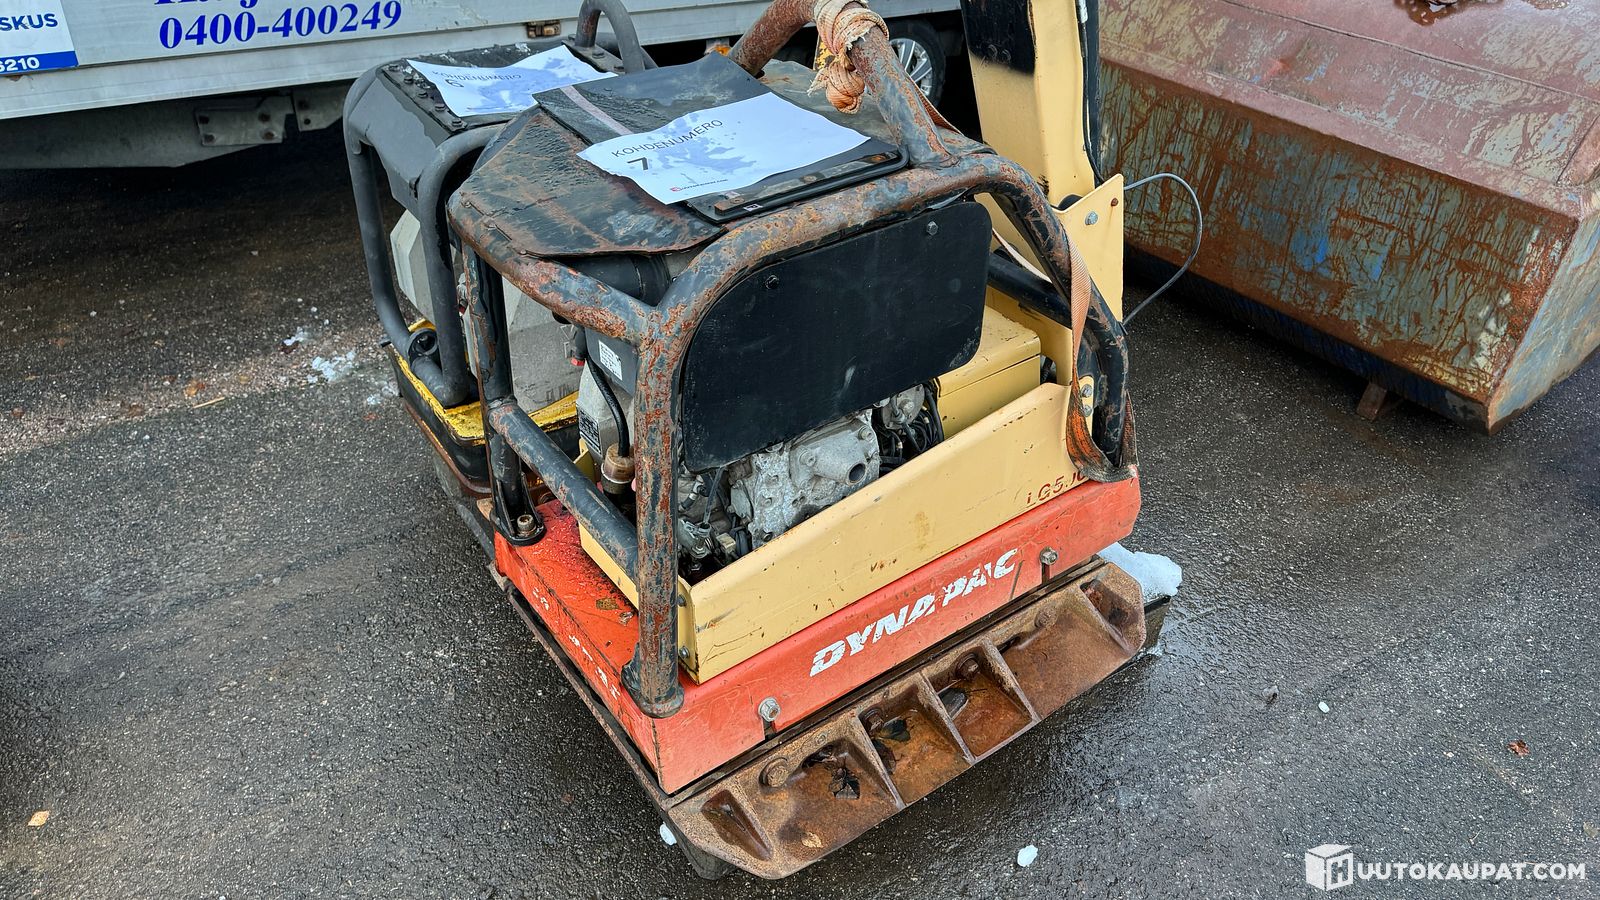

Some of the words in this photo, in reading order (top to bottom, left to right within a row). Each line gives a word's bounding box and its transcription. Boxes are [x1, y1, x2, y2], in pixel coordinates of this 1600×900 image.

[159, 0, 402, 49] 0400-400249
[611, 119, 723, 158] KOHDENUMERO
[626, 156, 649, 171] 7
